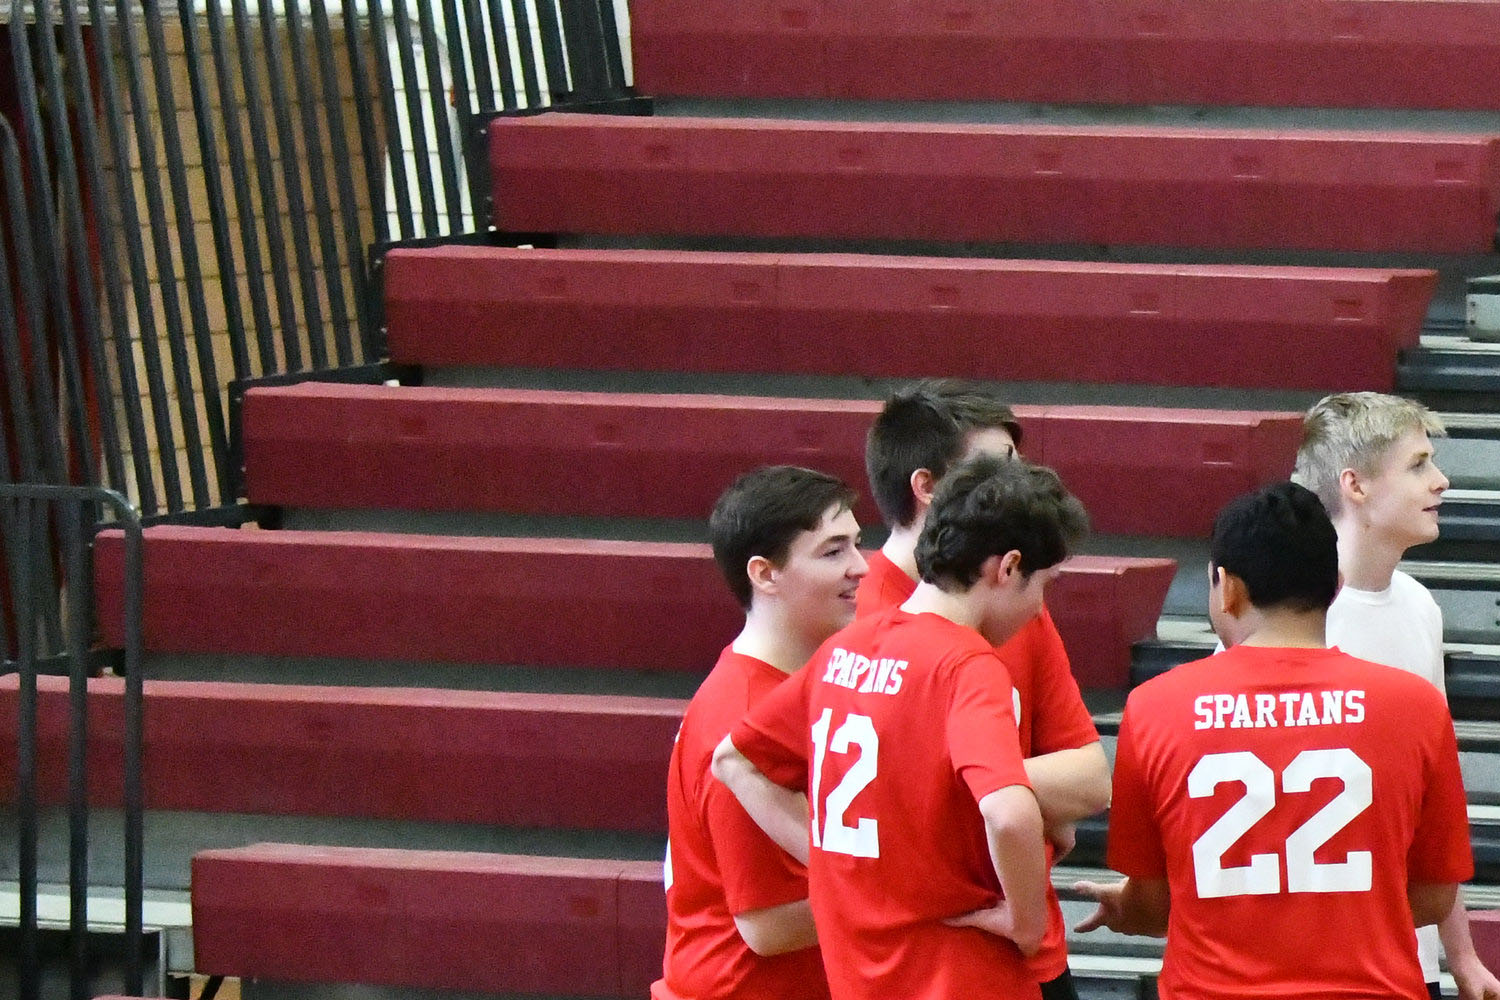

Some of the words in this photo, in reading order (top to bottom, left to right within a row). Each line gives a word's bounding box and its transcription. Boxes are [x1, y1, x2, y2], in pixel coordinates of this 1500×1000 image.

[811, 707, 879, 858] 12
[1194, 689, 1365, 730] SPARTANS
[1187, 748, 1373, 898] 22
